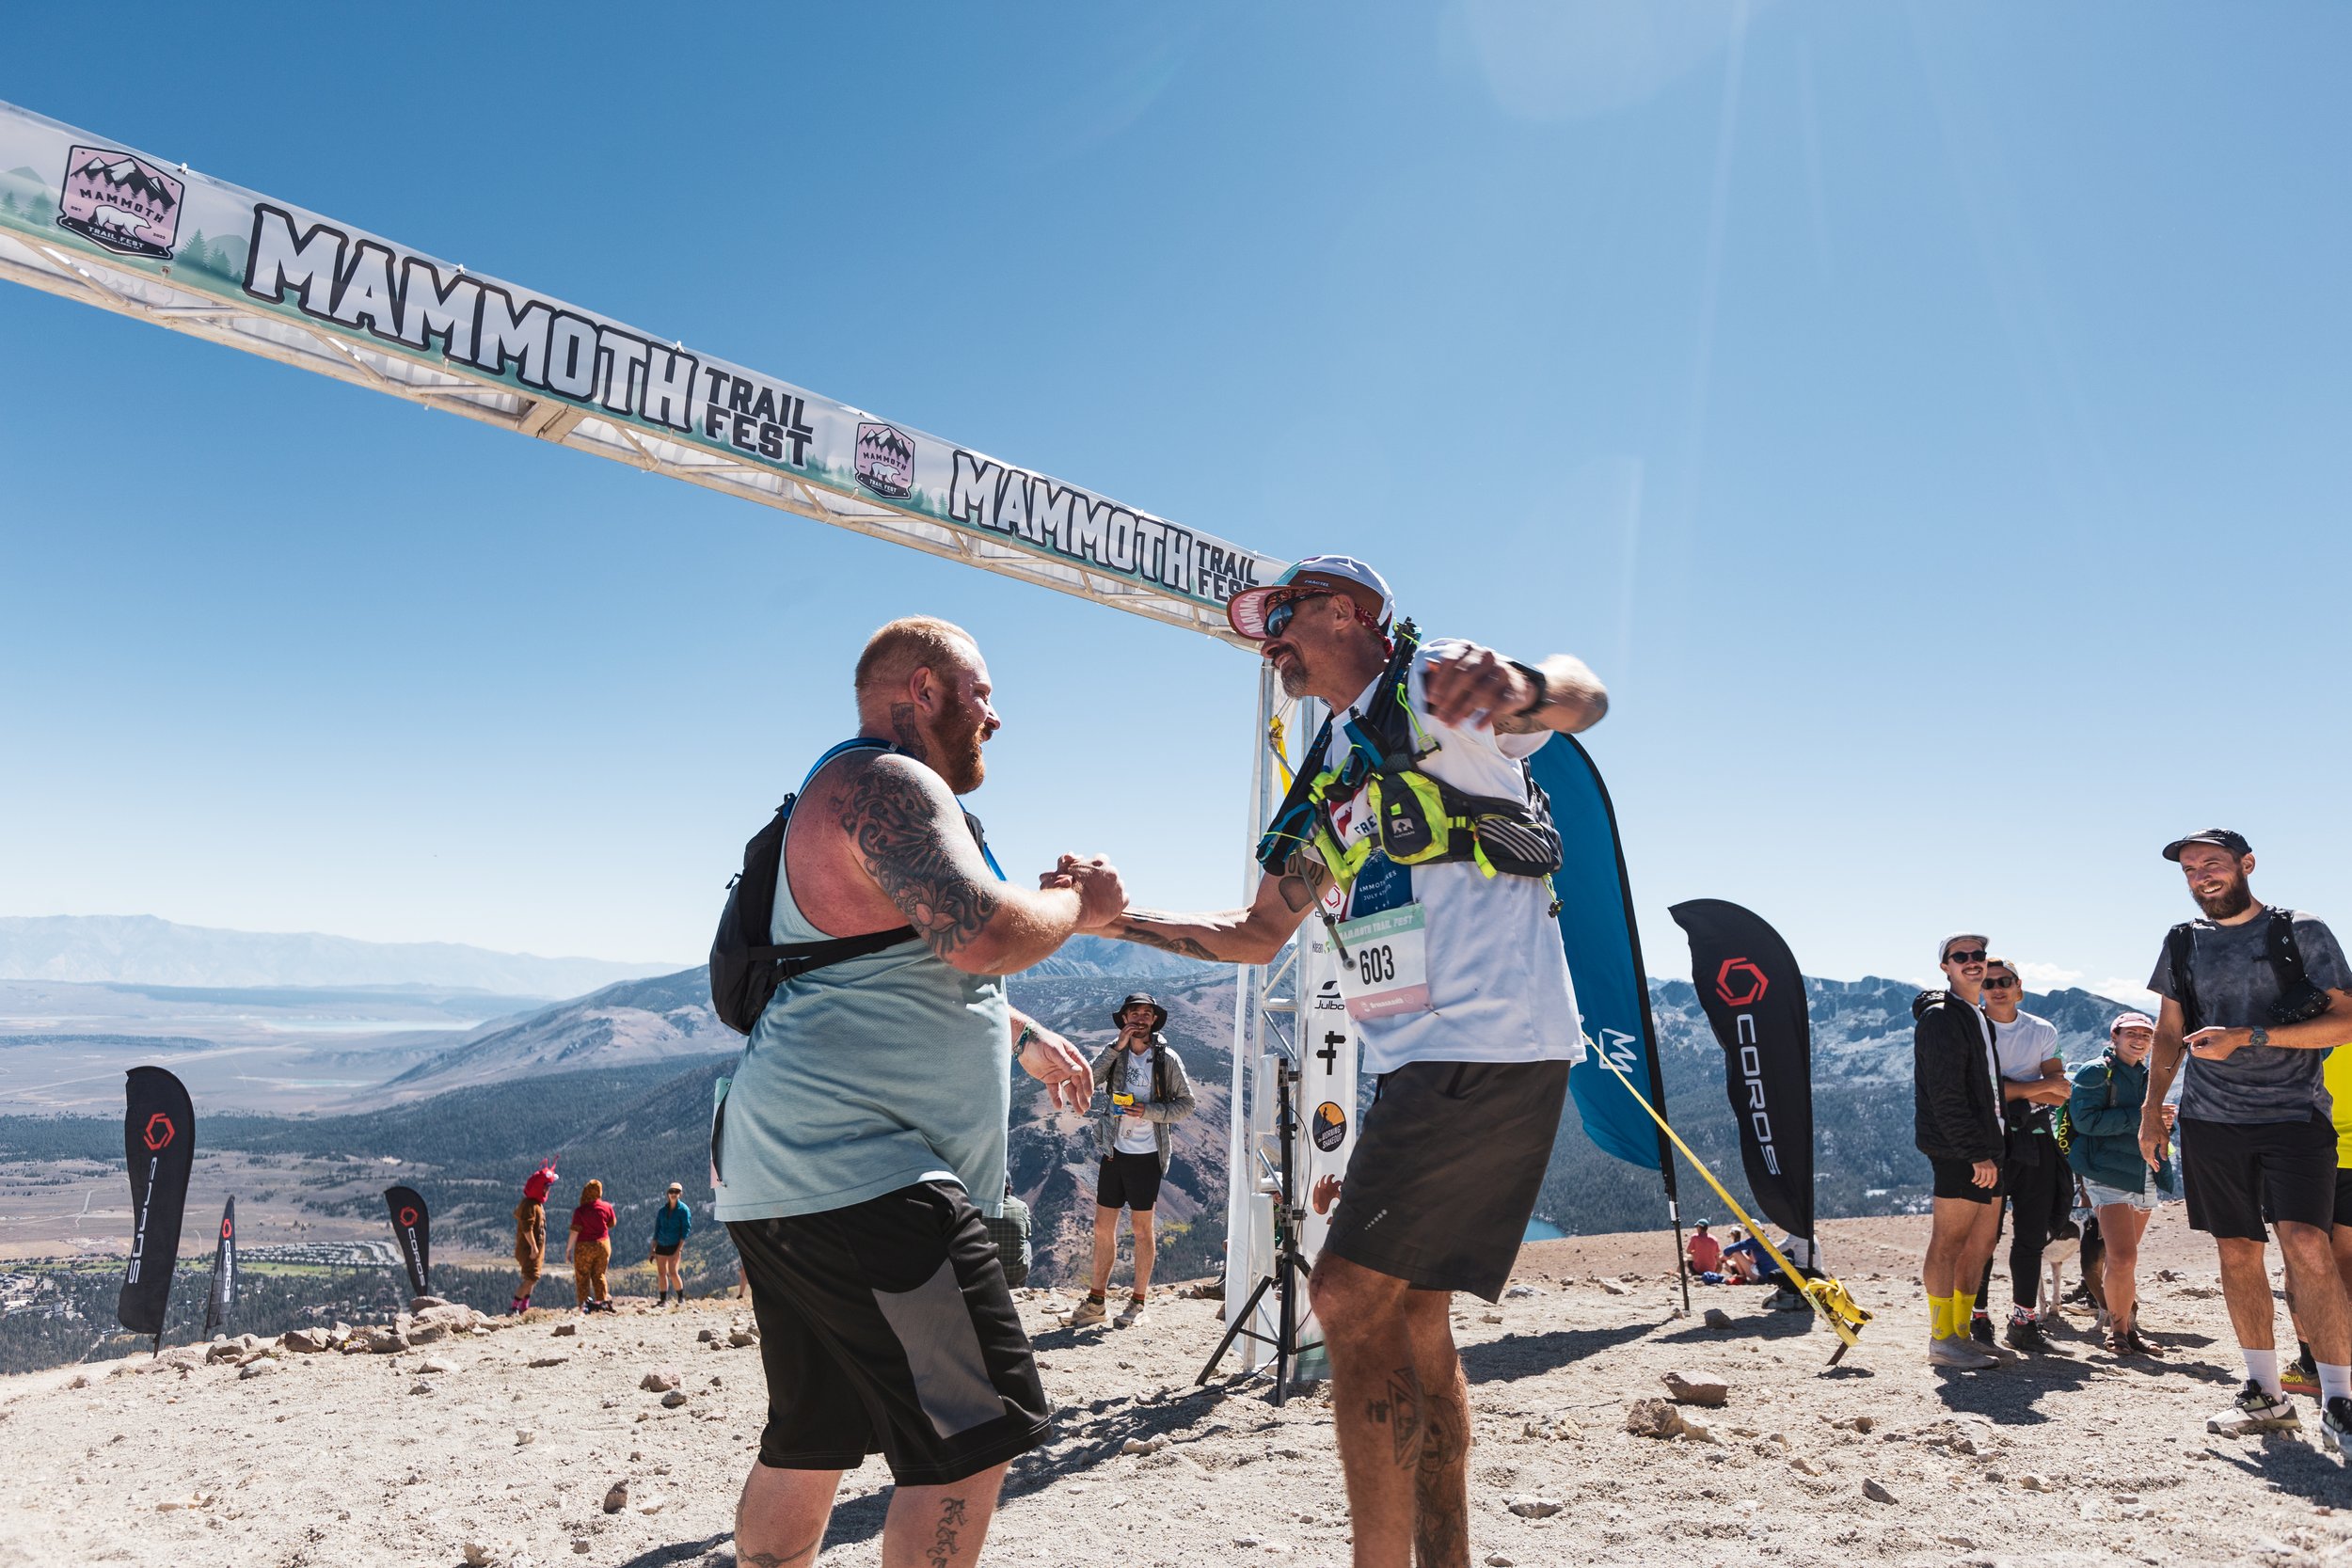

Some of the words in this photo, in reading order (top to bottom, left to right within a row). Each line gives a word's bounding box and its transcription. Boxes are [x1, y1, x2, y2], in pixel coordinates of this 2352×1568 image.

[80, 188, 165, 224] MAMMOTH
[87, 226, 117, 240] TRAIL
[119, 236, 145, 248] FEST
[243, 203, 699, 433] MAMMOTH
[705, 366, 814, 435] TRAIL
[706, 404, 813, 467] FEST
[863, 451, 907, 471] MAMMOTH
[869, 479, 882, 489] TRAIL
[884, 483, 897, 493] FEST
[948, 450, 1193, 594] MAMMOTH
[1196, 540, 1260, 584] TRAIL
[1374, 919, 1392, 933] TRAIL
[1393, 914, 1414, 927] FEST
[1359, 944, 1395, 986] 603
[1314, 1000, 1345, 1011] Julbo
[1736, 1013, 1781, 1176] COROS
[223, 1239, 233, 1303] COROS
[408, 1227, 426, 1287] COROS
